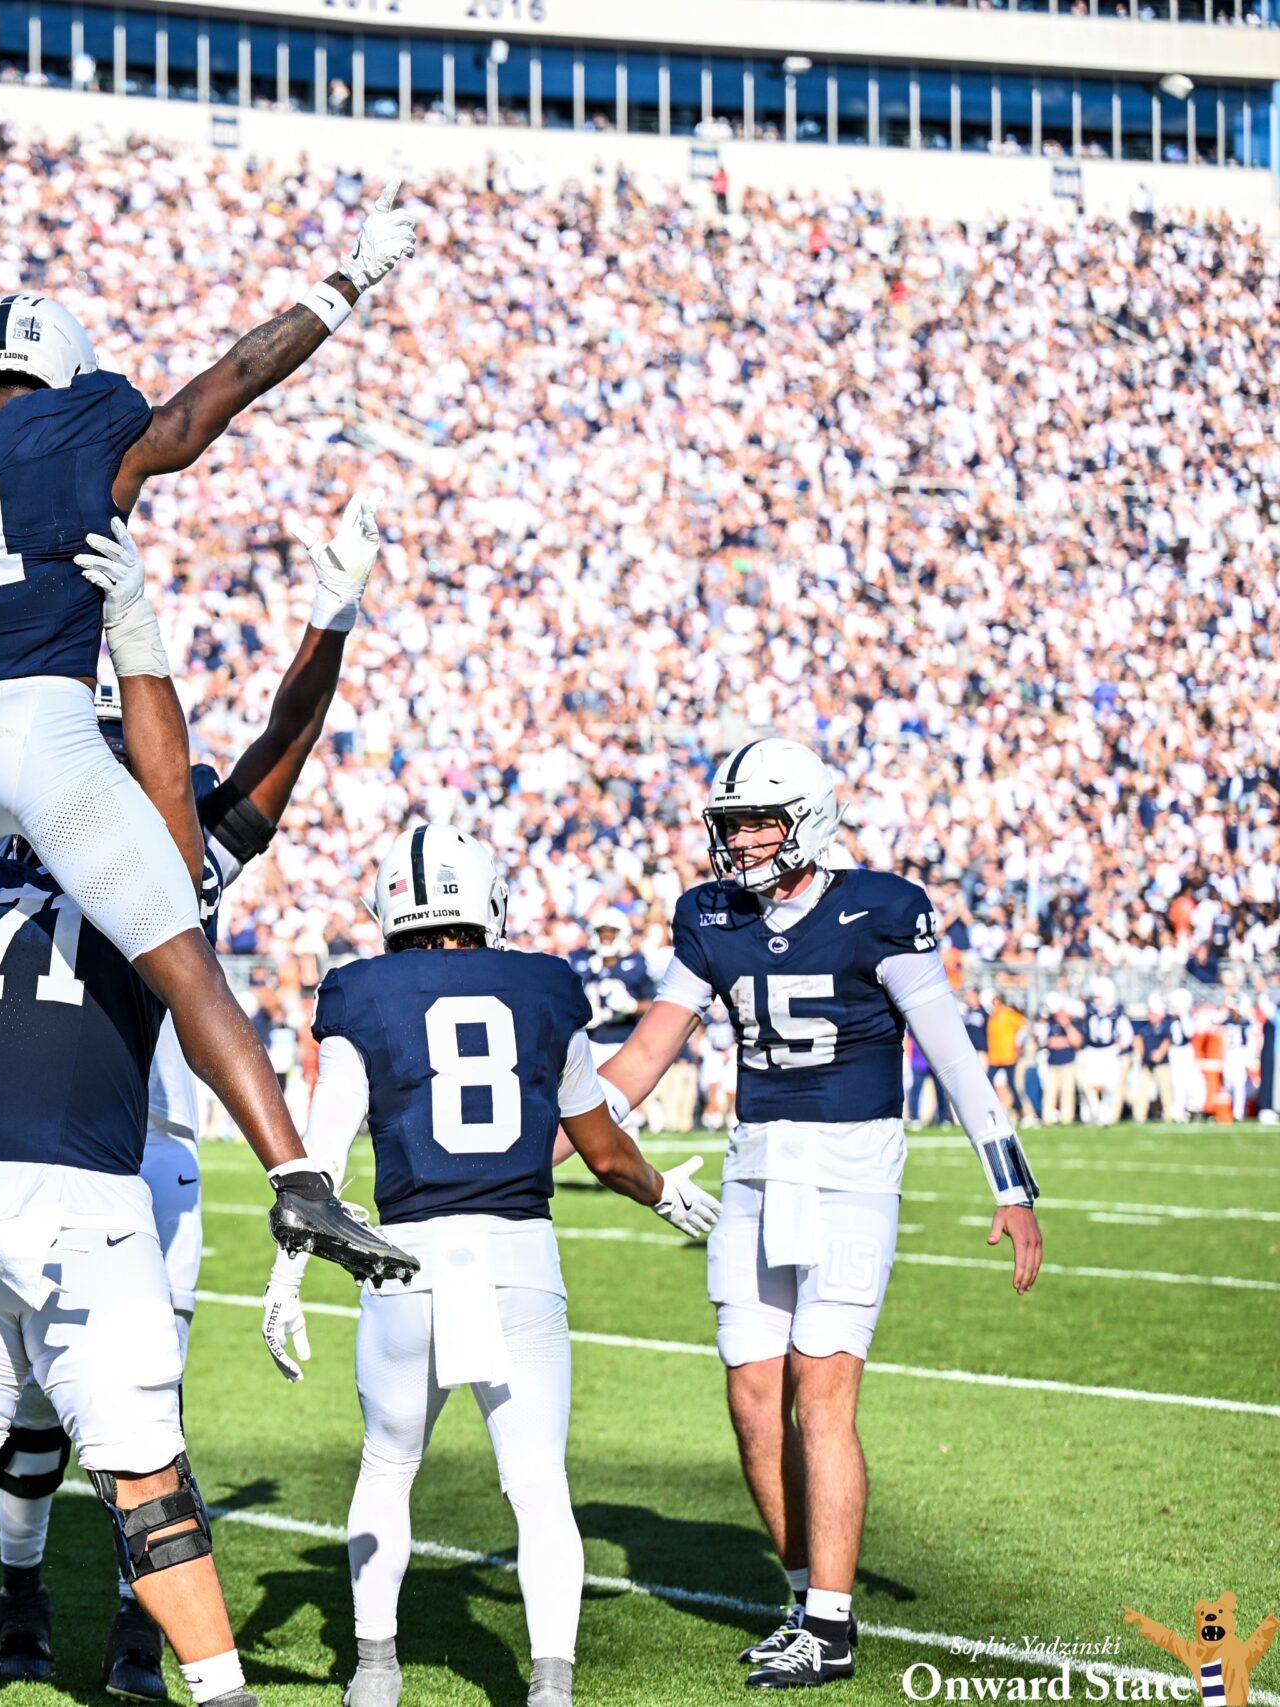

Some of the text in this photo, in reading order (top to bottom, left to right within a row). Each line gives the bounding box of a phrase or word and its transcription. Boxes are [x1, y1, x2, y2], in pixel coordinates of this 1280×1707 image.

[4, 352, 29, 361] LIONS
[432, 909, 460, 917] LIONS
[729, 974, 838, 1070] 15
[425, 996, 522, 1154] 8
